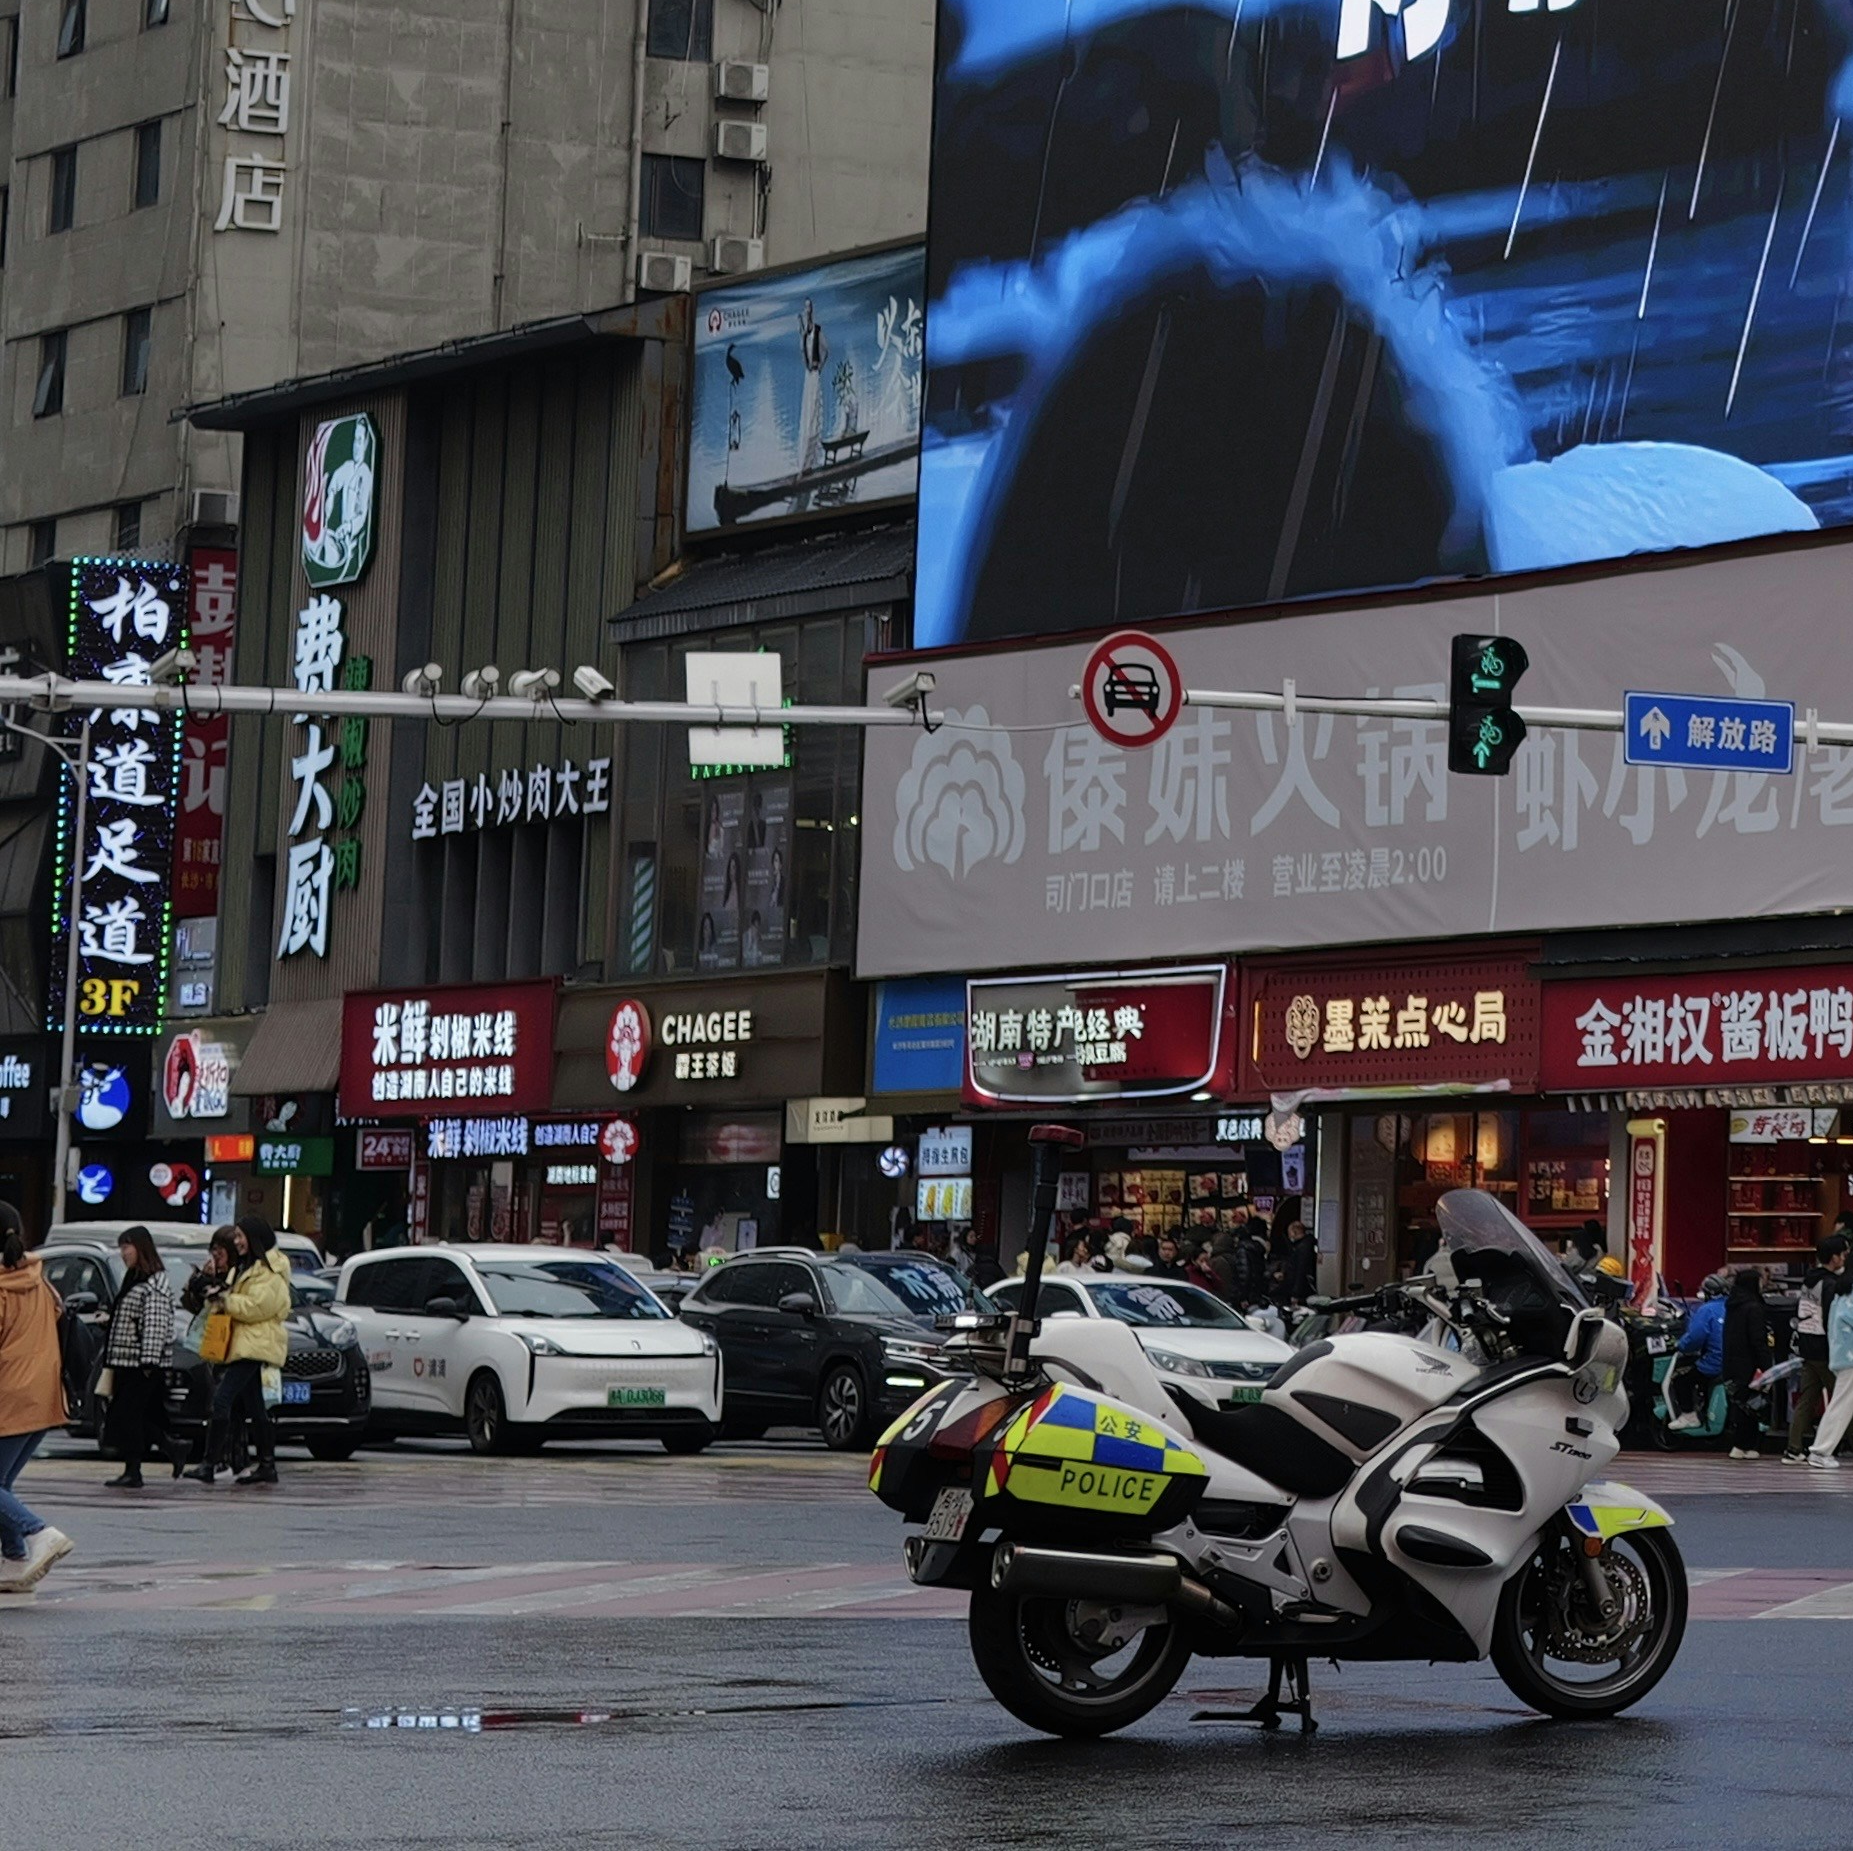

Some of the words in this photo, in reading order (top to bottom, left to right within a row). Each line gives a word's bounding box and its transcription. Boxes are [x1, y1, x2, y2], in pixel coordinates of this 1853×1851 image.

[1686, 713, 1778, 755] 解放路
[276, 594, 344, 961] 费大厨
[1043, 681, 1448, 856] 傣妹火锅
[411, 756, 610, 840] 全国小炒肉大王
[1045, 867, 1134, 914] 司门口店
[1152, 857, 1247, 907] 请上二楼
[1271, 845, 1448, 900] 营业至凌晨2:00
[80, 978, 140, 1016] 3F
[372, 999, 516, 1066] 米鲜剁椒米线
[661, 1010, 752, 1045] CHAGEE
[1322, 990, 1507, 1055] 墨茉点心局
[371, 1065, 515, 1102] 创造湖南人自己的米线
[675, 1051, 736, 1080] 霸王茶姬
[902, 1400, 948, 1442] 5
[1099, 1415, 1143, 1442] 公安
[1060, 1468, 1157, 1503] POLICE
